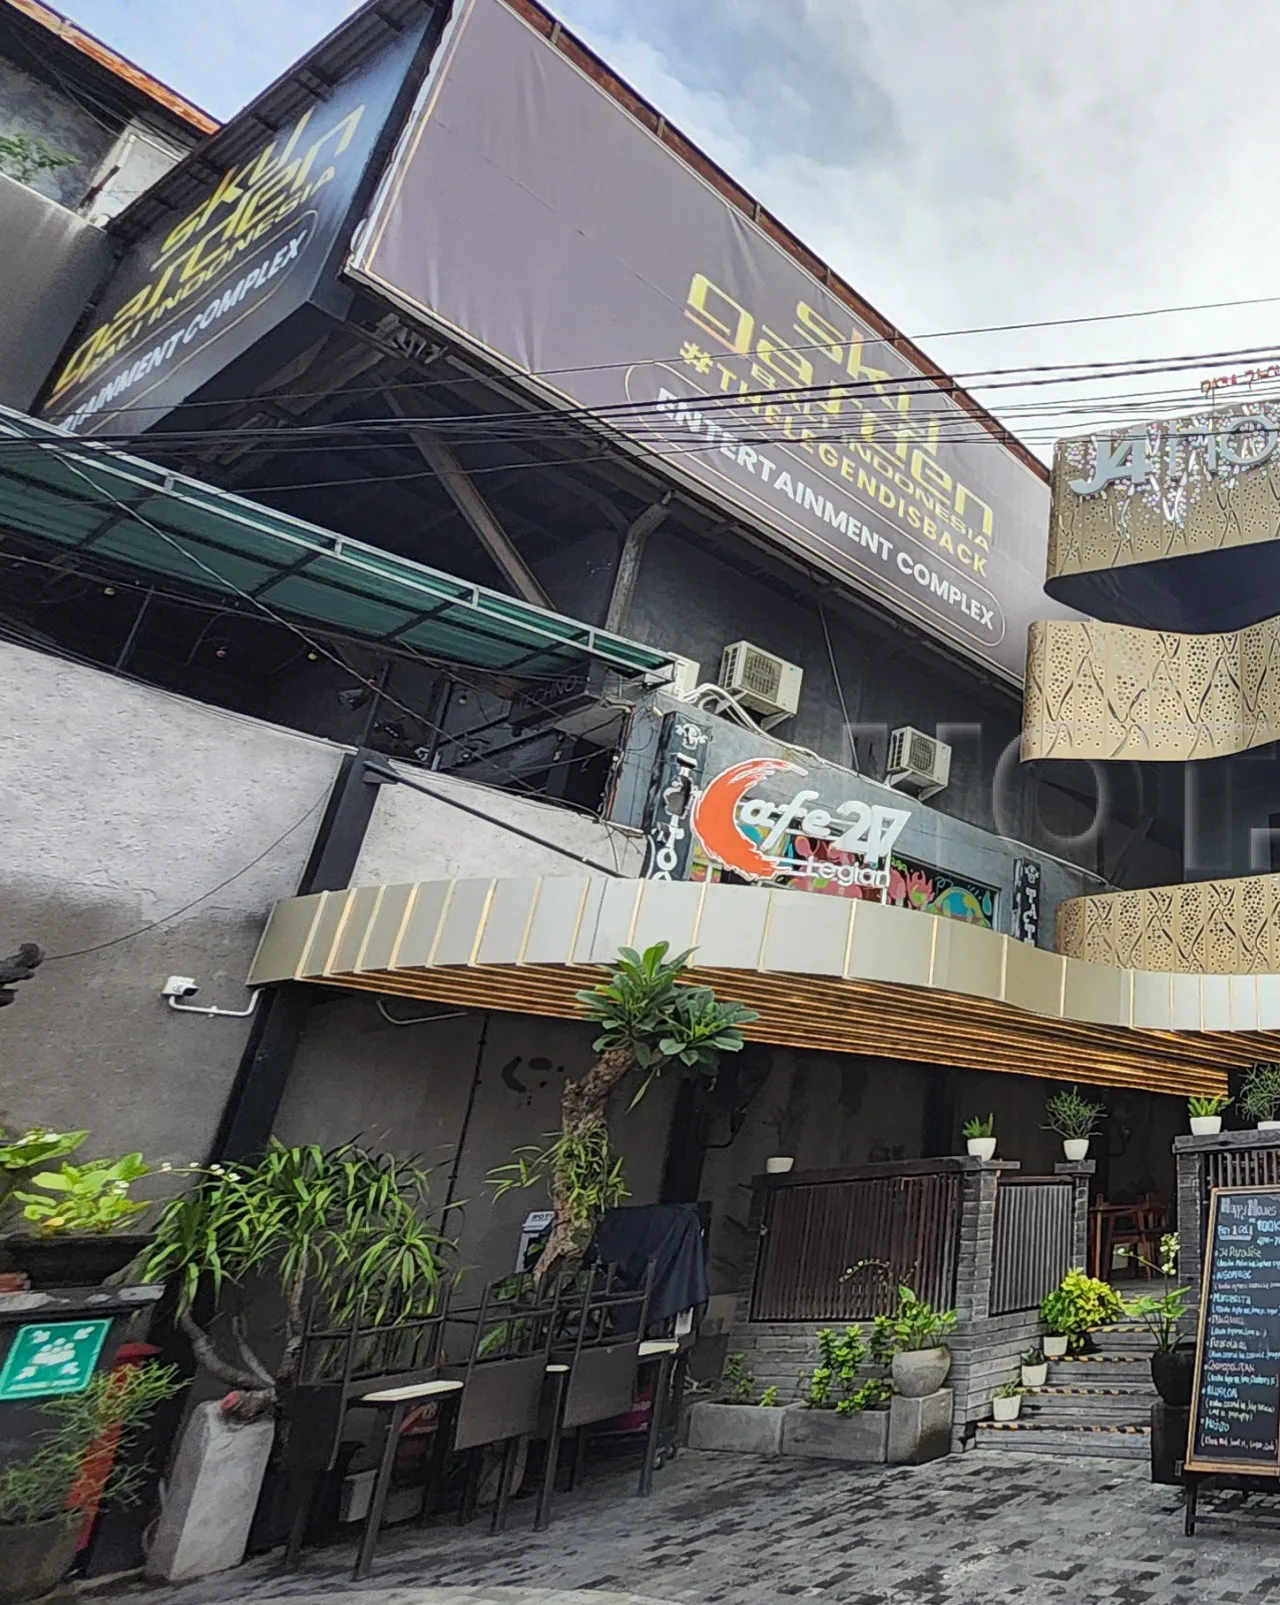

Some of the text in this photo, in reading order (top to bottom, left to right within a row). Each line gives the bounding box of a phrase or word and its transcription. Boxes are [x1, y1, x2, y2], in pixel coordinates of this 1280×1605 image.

[182, 229, 308, 344] COMPLEX
[656, 387, 993, 630] ENTERTAINMENT COMPLEX
